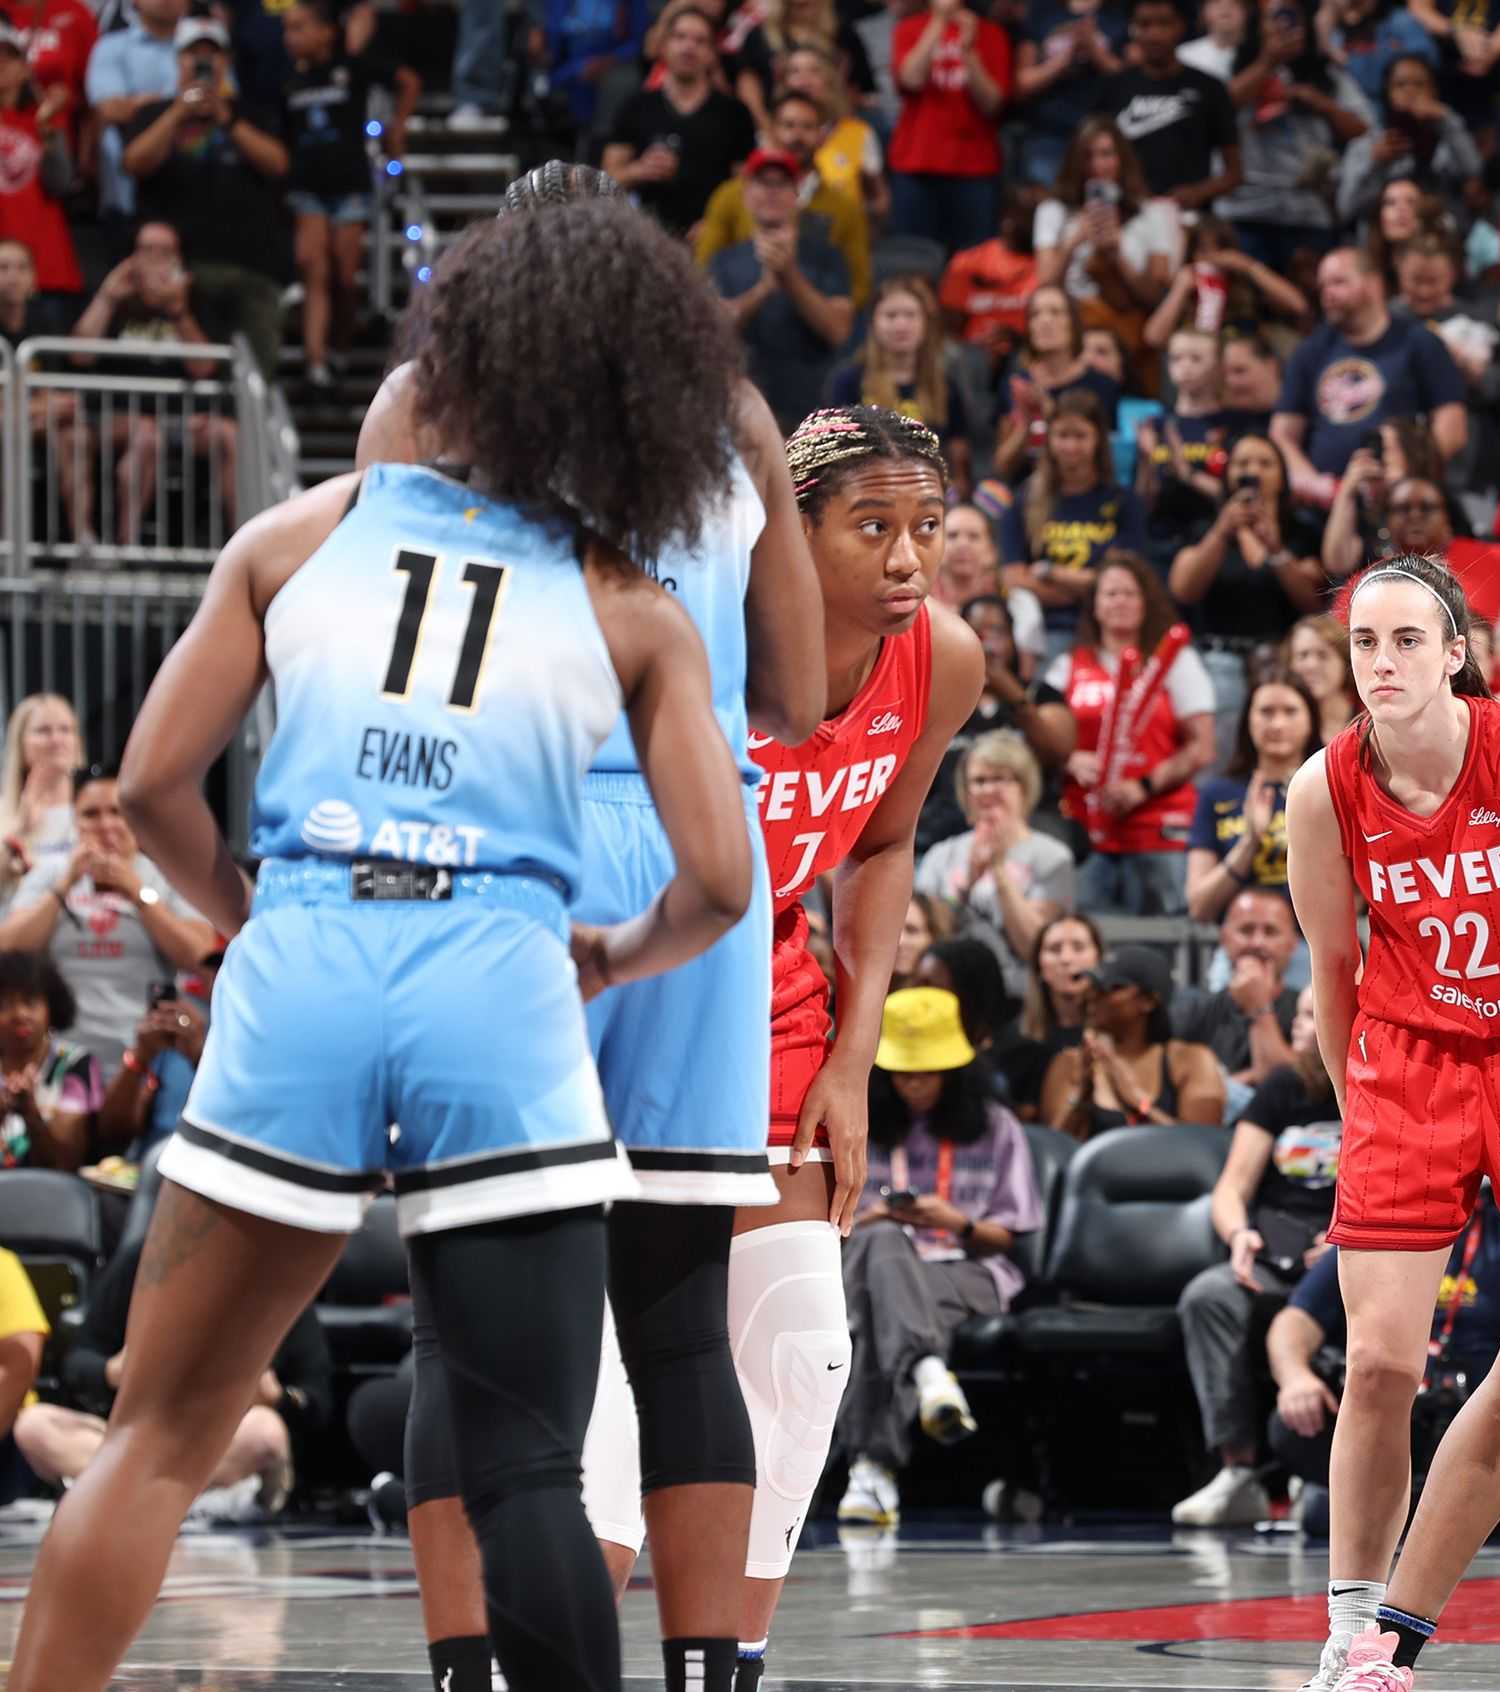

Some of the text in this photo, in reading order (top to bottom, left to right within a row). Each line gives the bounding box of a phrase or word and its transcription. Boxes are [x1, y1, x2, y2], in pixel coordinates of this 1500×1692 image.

[381, 544, 510, 715] 11
[867, 711, 903, 735] Lilly
[356, 727, 458, 792] EVANS
[753, 753, 897, 821] FEVER
[369, 818, 487, 867] AT&T
[1418, 911, 1500, 980] 22
